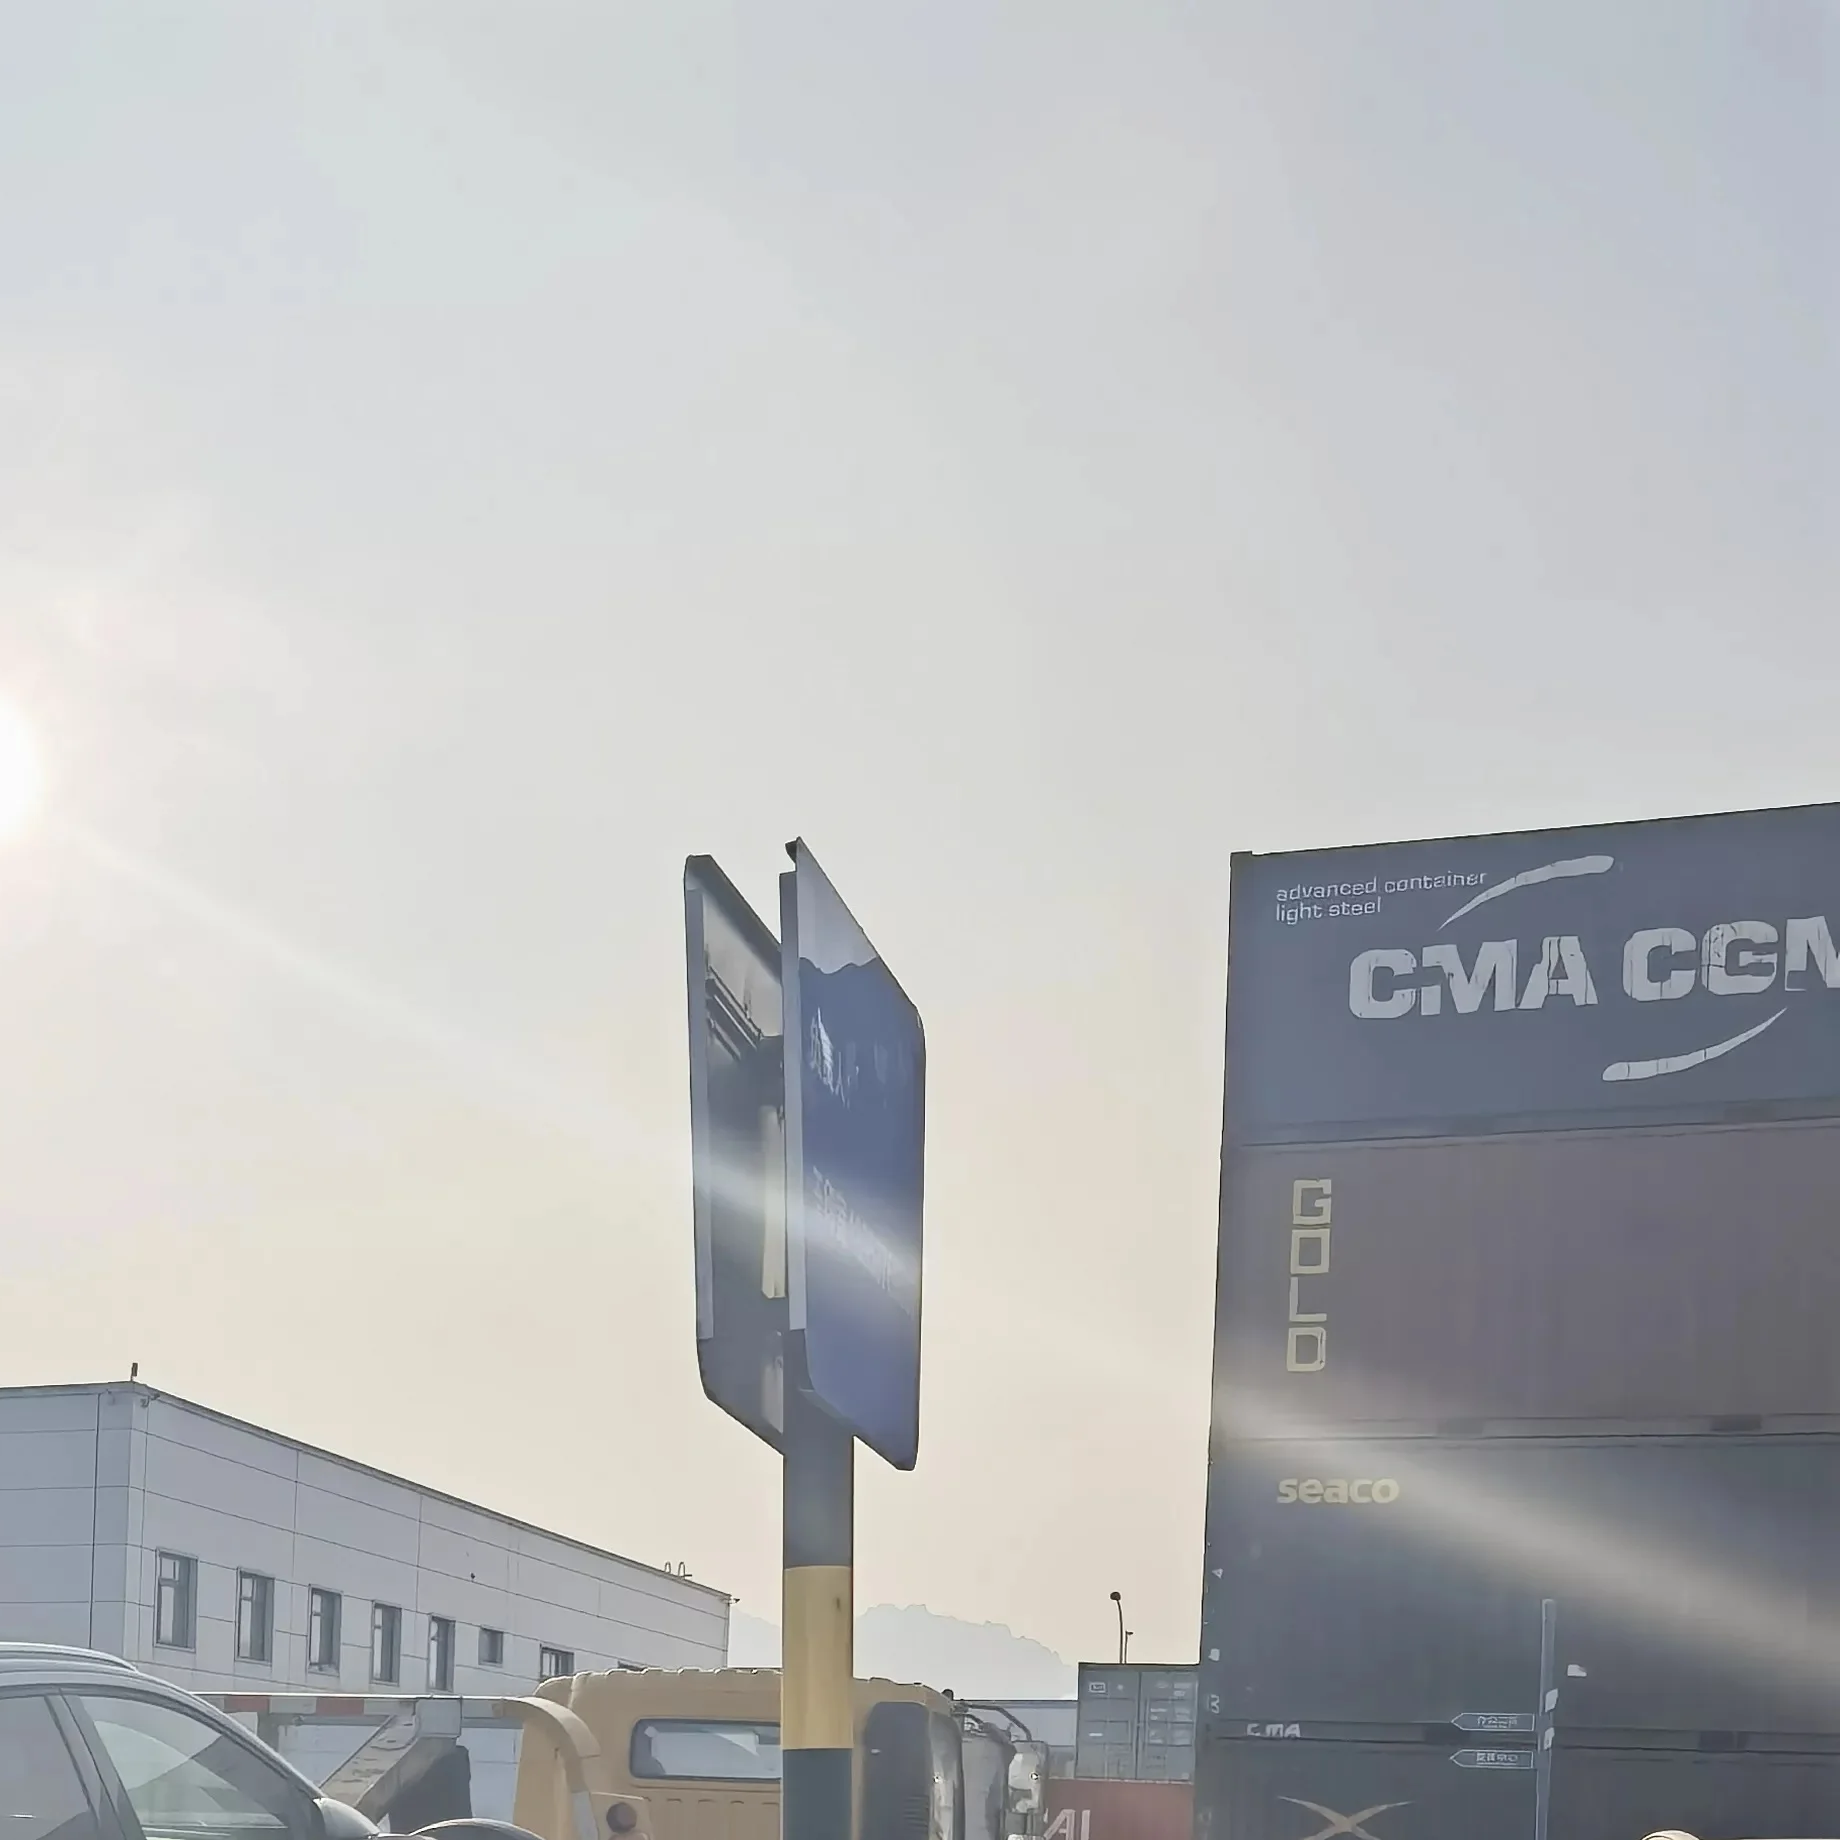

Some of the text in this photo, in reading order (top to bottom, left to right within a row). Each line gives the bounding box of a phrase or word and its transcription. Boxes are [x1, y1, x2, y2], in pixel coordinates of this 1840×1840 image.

[1276, 870, 1488, 901] advanced container
[1276, 896, 1382, 925] light steel
[1348, 935, 1599, 1019] CMA
[1286, 1177, 1332, 1372] GOLD
[1276, 1478, 1400, 1504] seaco
